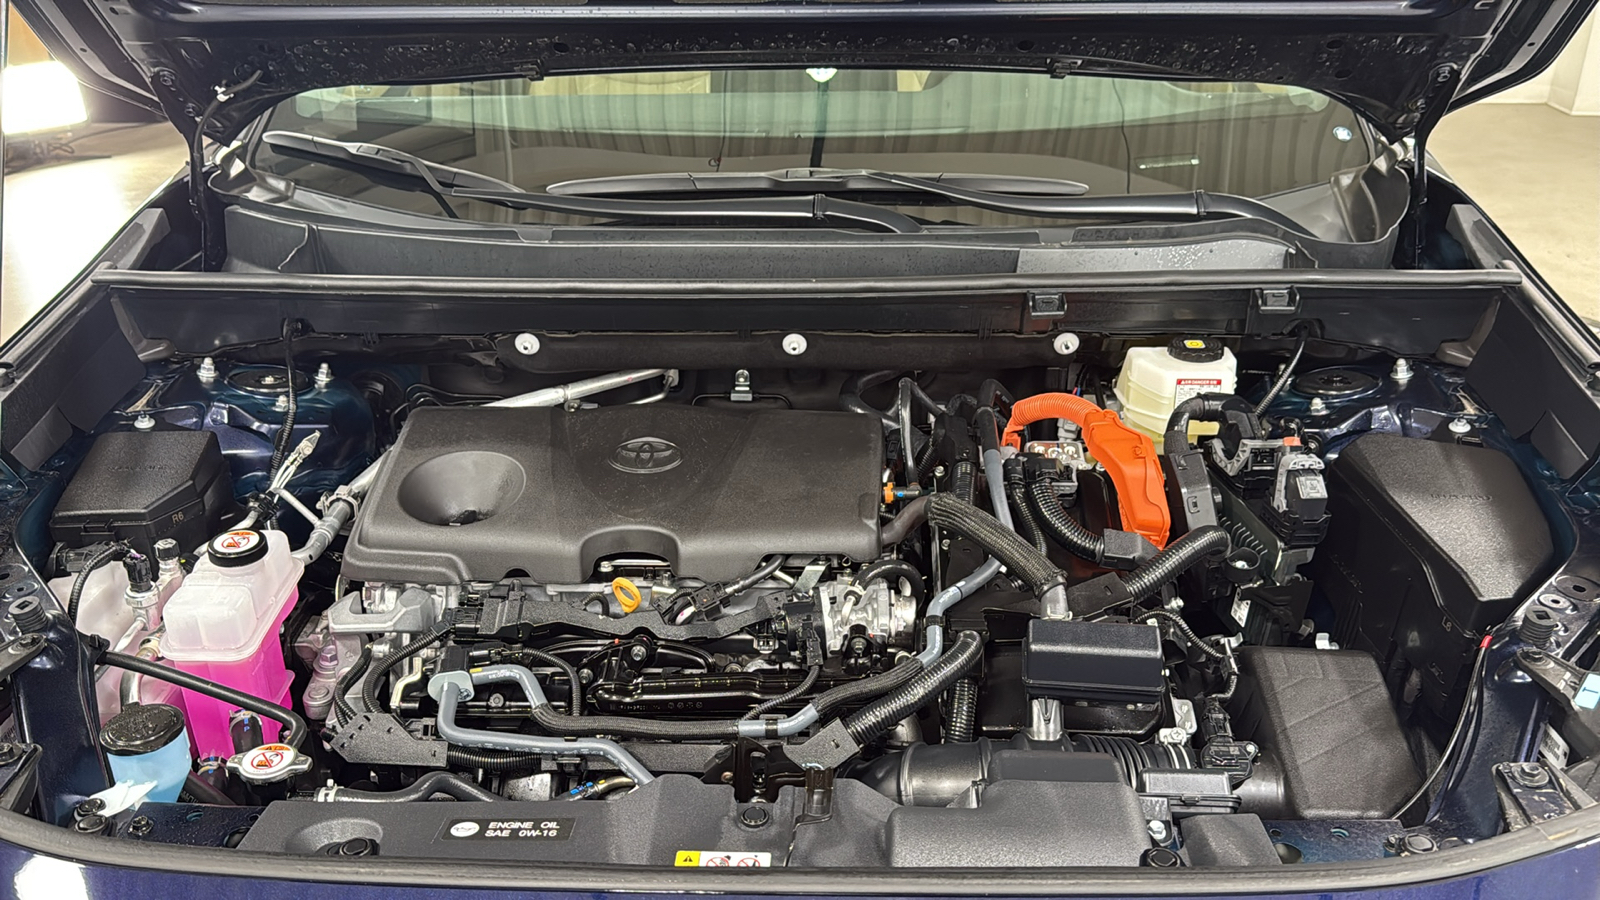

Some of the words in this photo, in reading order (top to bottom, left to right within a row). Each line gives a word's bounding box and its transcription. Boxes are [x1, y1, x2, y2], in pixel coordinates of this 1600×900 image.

[171, 511, 185, 524] R6
[488, 821, 535, 829] ENGINE
[540, 821, 560, 829] OIL
[484, 829, 512, 837] SAE
[518, 829, 558, 837] 0W-16
